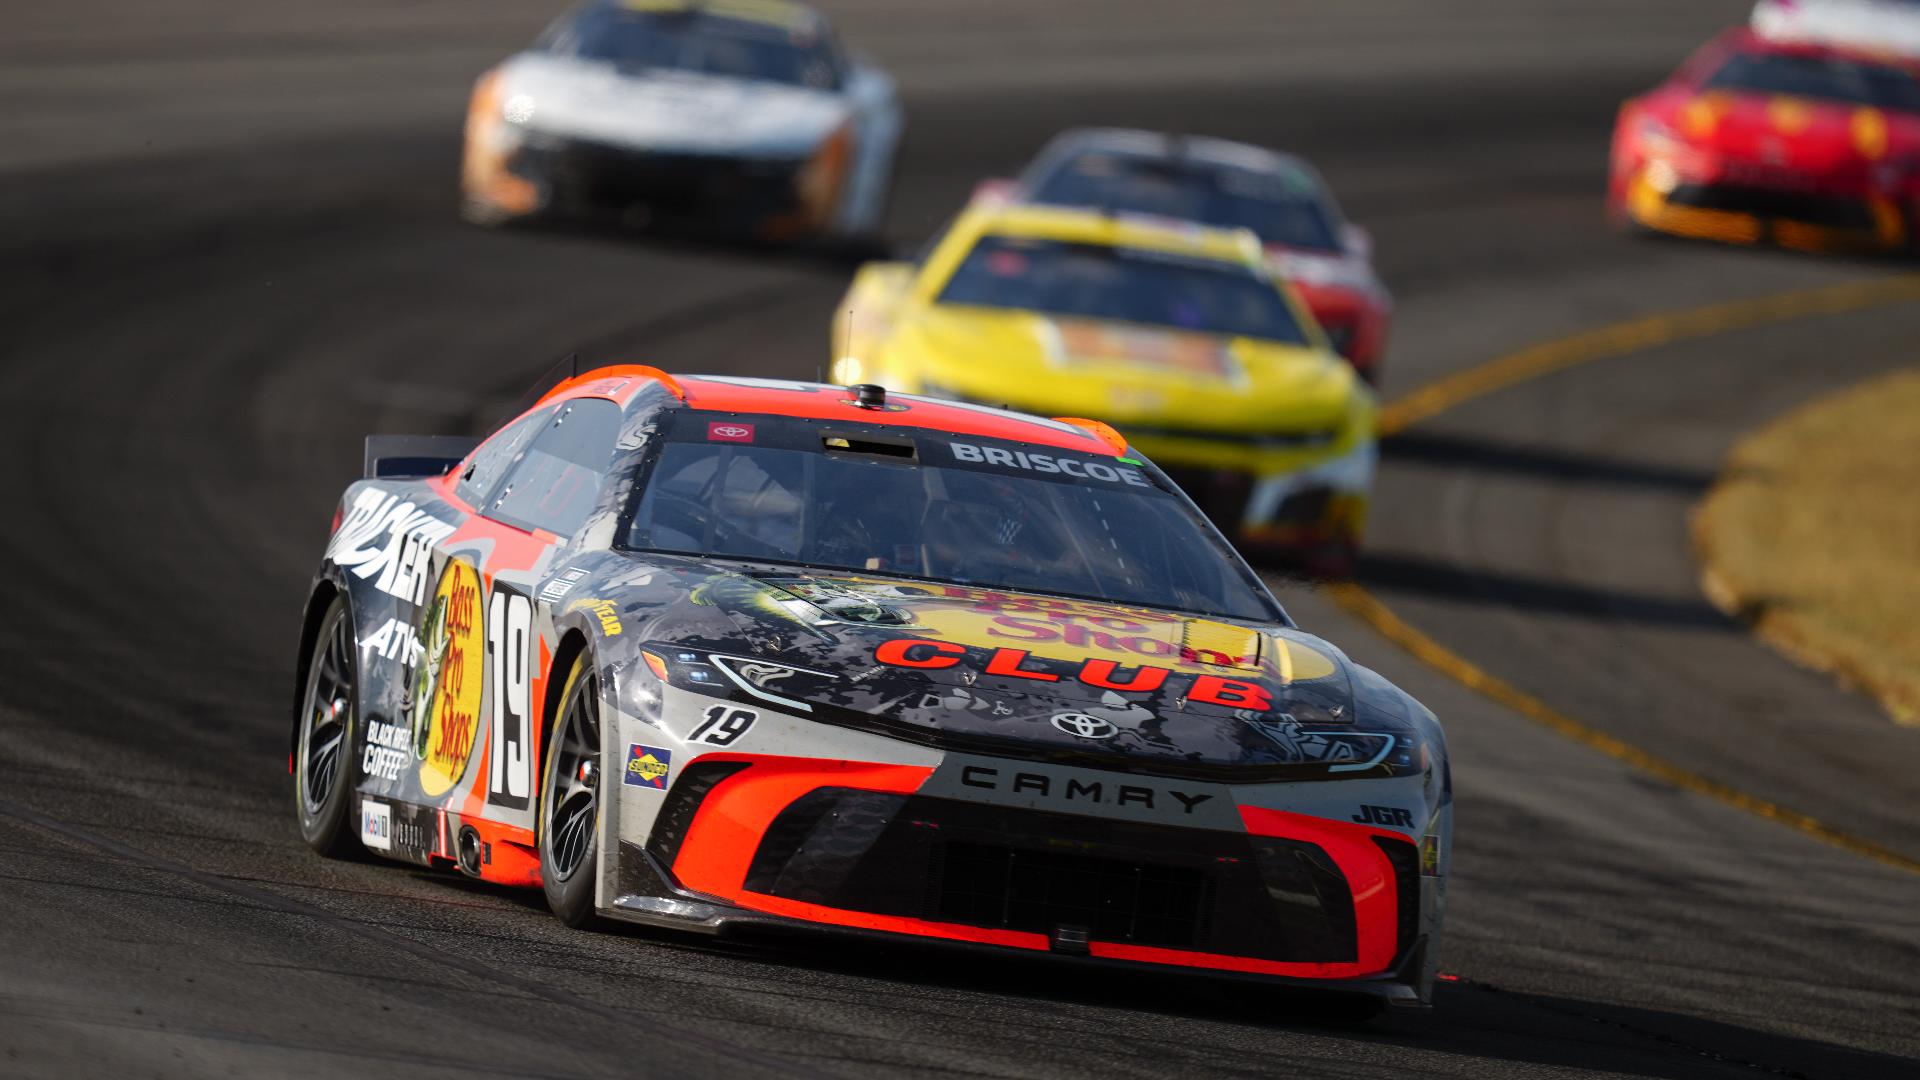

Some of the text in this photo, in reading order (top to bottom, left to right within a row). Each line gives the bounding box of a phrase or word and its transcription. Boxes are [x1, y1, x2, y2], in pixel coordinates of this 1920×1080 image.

[950, 442, 1150, 488] BRISCOE
[323, 487, 457, 607] TRACKER
[447, 564, 475, 634] Bass
[441, 630, 464, 694] Pro
[875, 638, 1274, 712] CLUB
[489, 591, 532, 799] 19
[367, 720, 395, 747] BLACK
[434, 692, 472, 778] Shops
[687, 705, 757, 746] 19
[363, 743, 405, 781] COFFEE
[629, 759, 668, 776] SUNOCO
[961, 765, 1214, 814] CAMRY
[1352, 804, 1416, 829] JGR
